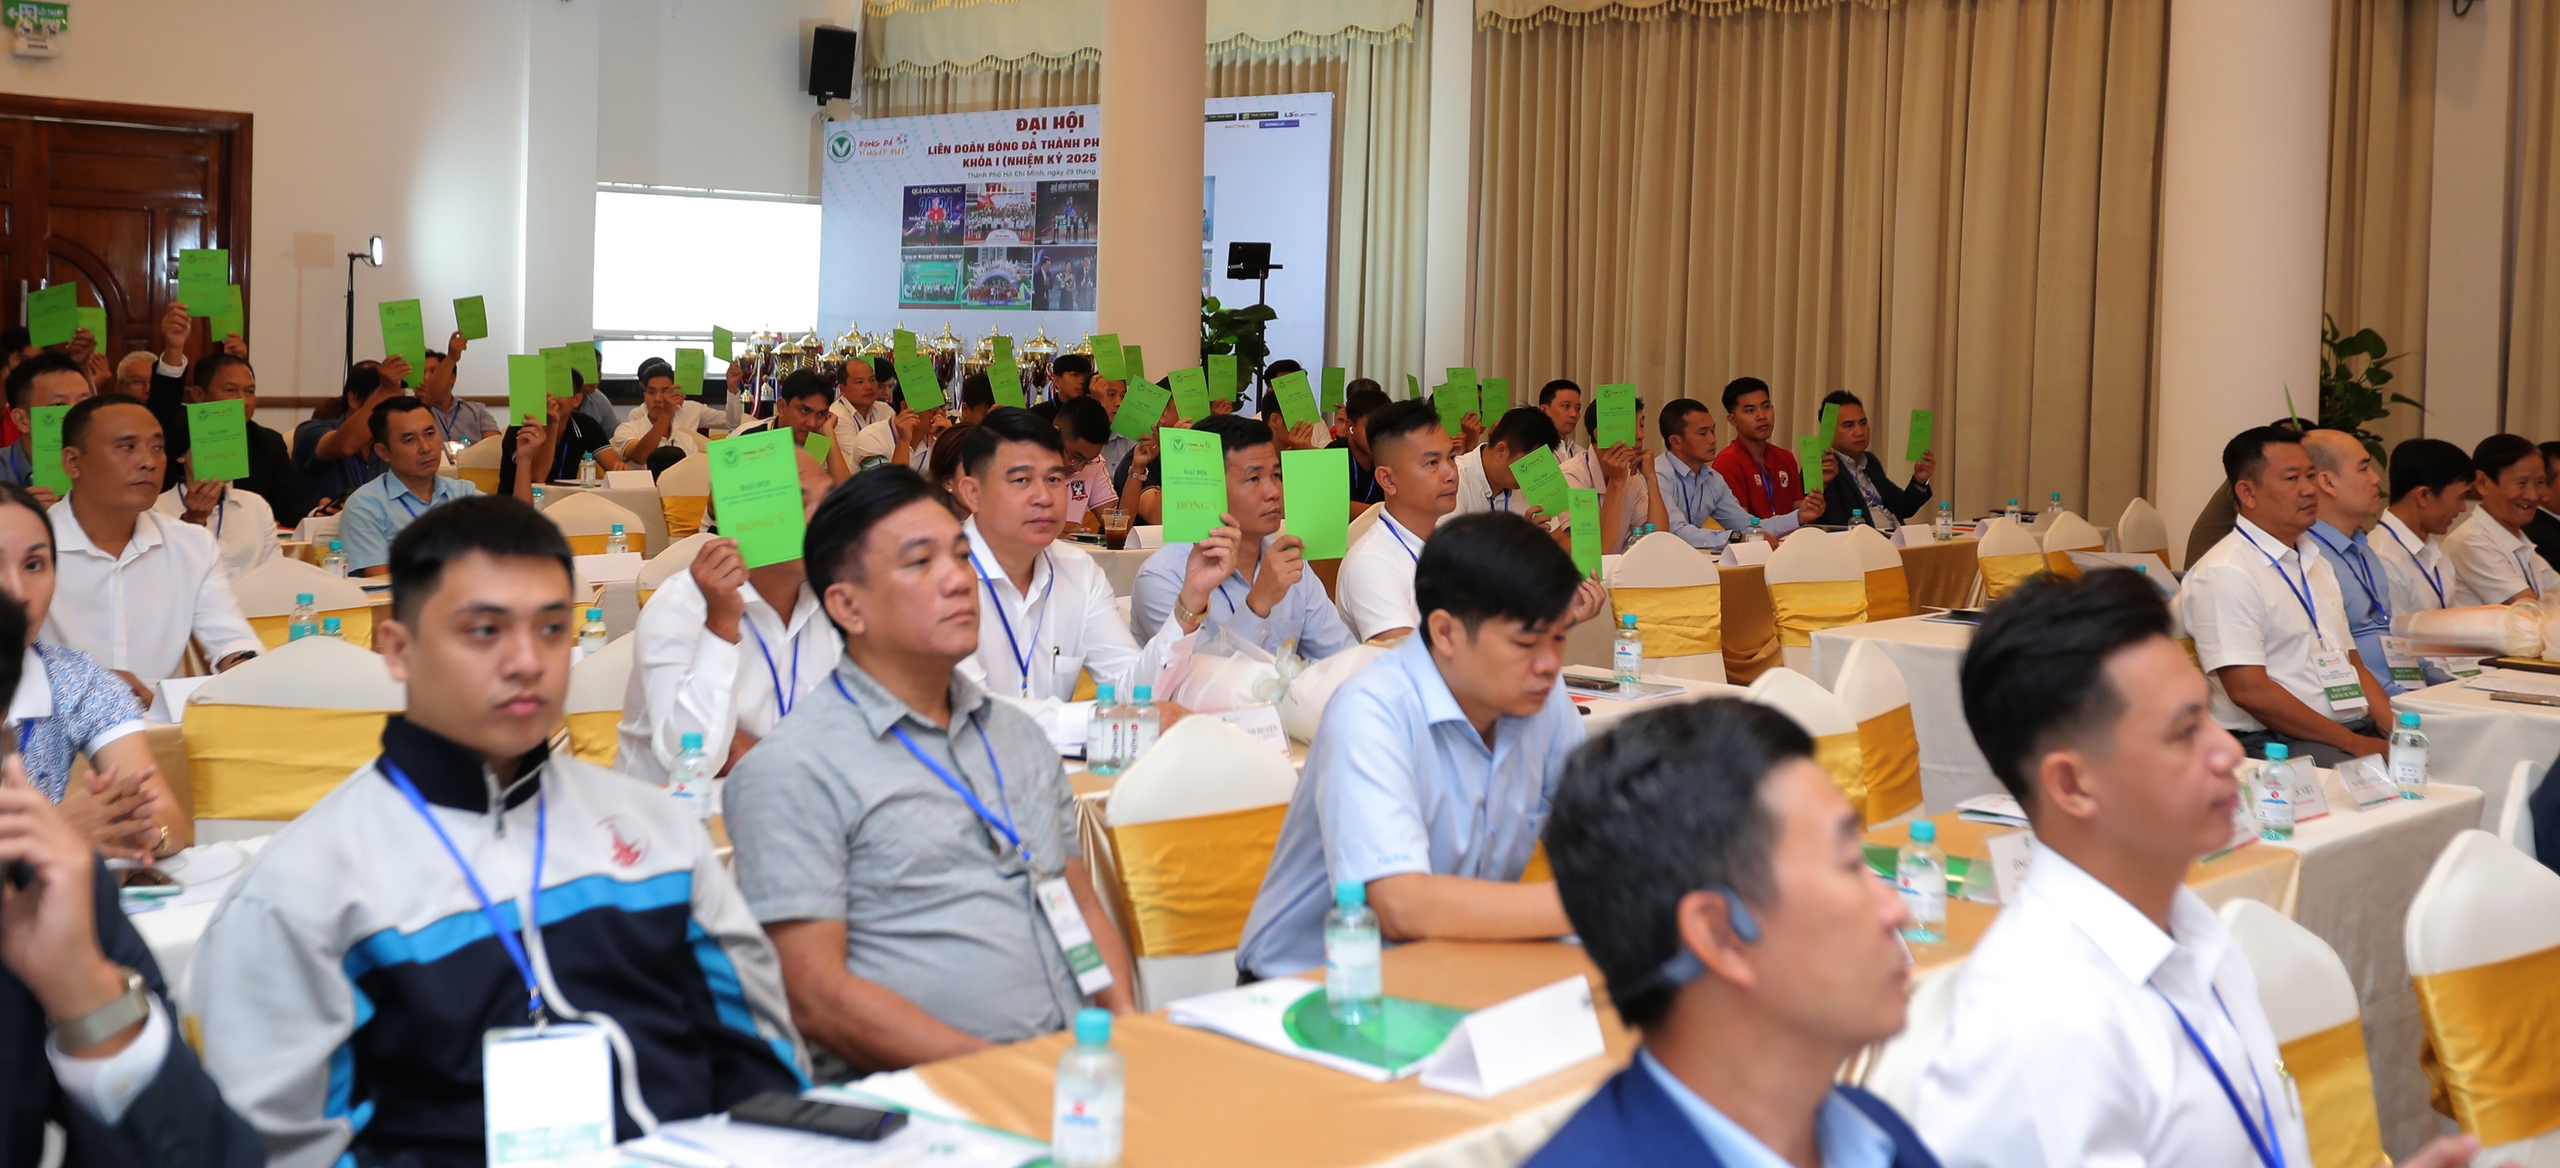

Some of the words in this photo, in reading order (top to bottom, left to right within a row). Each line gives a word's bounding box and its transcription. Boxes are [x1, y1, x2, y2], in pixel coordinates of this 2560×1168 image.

[1016, 116, 1047, 135] ĐẠI
[1053, 111, 1084, 133] HỘI
[928, 142, 951, 155] LIÊN
[988, 139, 1019, 152] BÓNG
[1021, 138, 1037, 150] ĐÁ
[1041, 136, 1080, 149] THÀNH
[1083, 138, 1099, 147] PH
[962, 155, 992, 168] KHÓA
[995, 157, 1000, 166] I
[1002, 152, 1044, 168] (NHIỆM
[1047, 152, 1063, 164] KỲ
[1066, 153, 1097, 164] 2025
[1047, 169, 1064, 177] ngày
[1075, 168, 1097, 176] tháng
[923, 186, 938, 194] BÓNG
